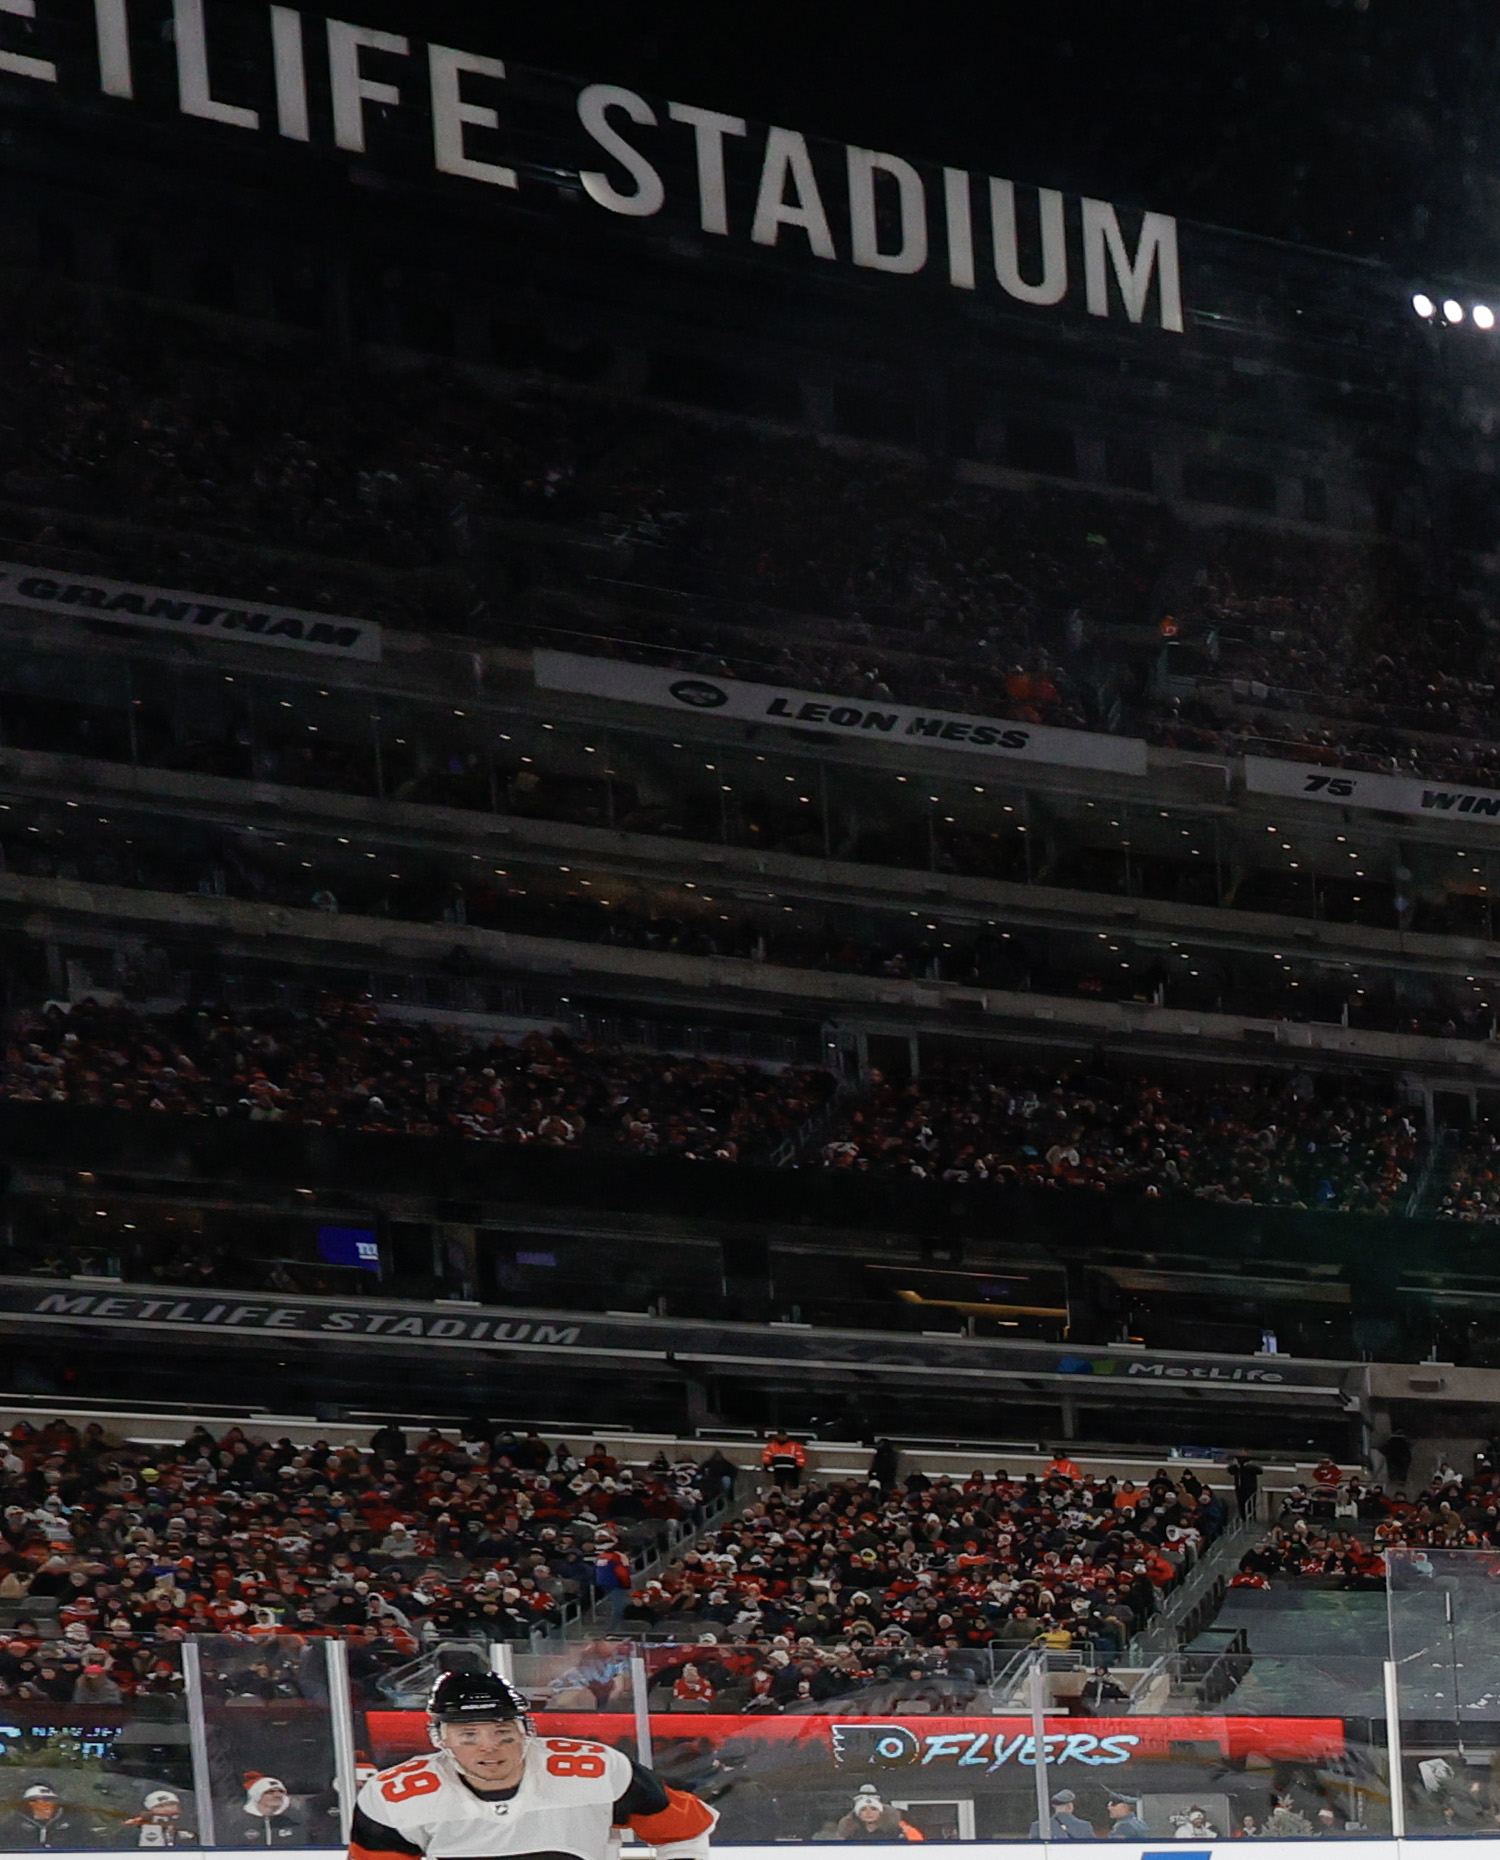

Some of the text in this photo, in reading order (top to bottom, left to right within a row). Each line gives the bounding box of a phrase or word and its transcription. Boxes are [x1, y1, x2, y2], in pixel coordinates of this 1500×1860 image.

[577, 82, 1188, 334] STADIUM
[17, 577, 362, 648] GRANTHAM
[766, 698, 1030, 749] LEON HESS
[1304, 775, 1354, 797] 75
[35, 1293, 581, 1346] METLIFE STADIUM
[1127, 1361, 1284, 1383] MetLife
[920, 1732, 1140, 1775] FLYERS
